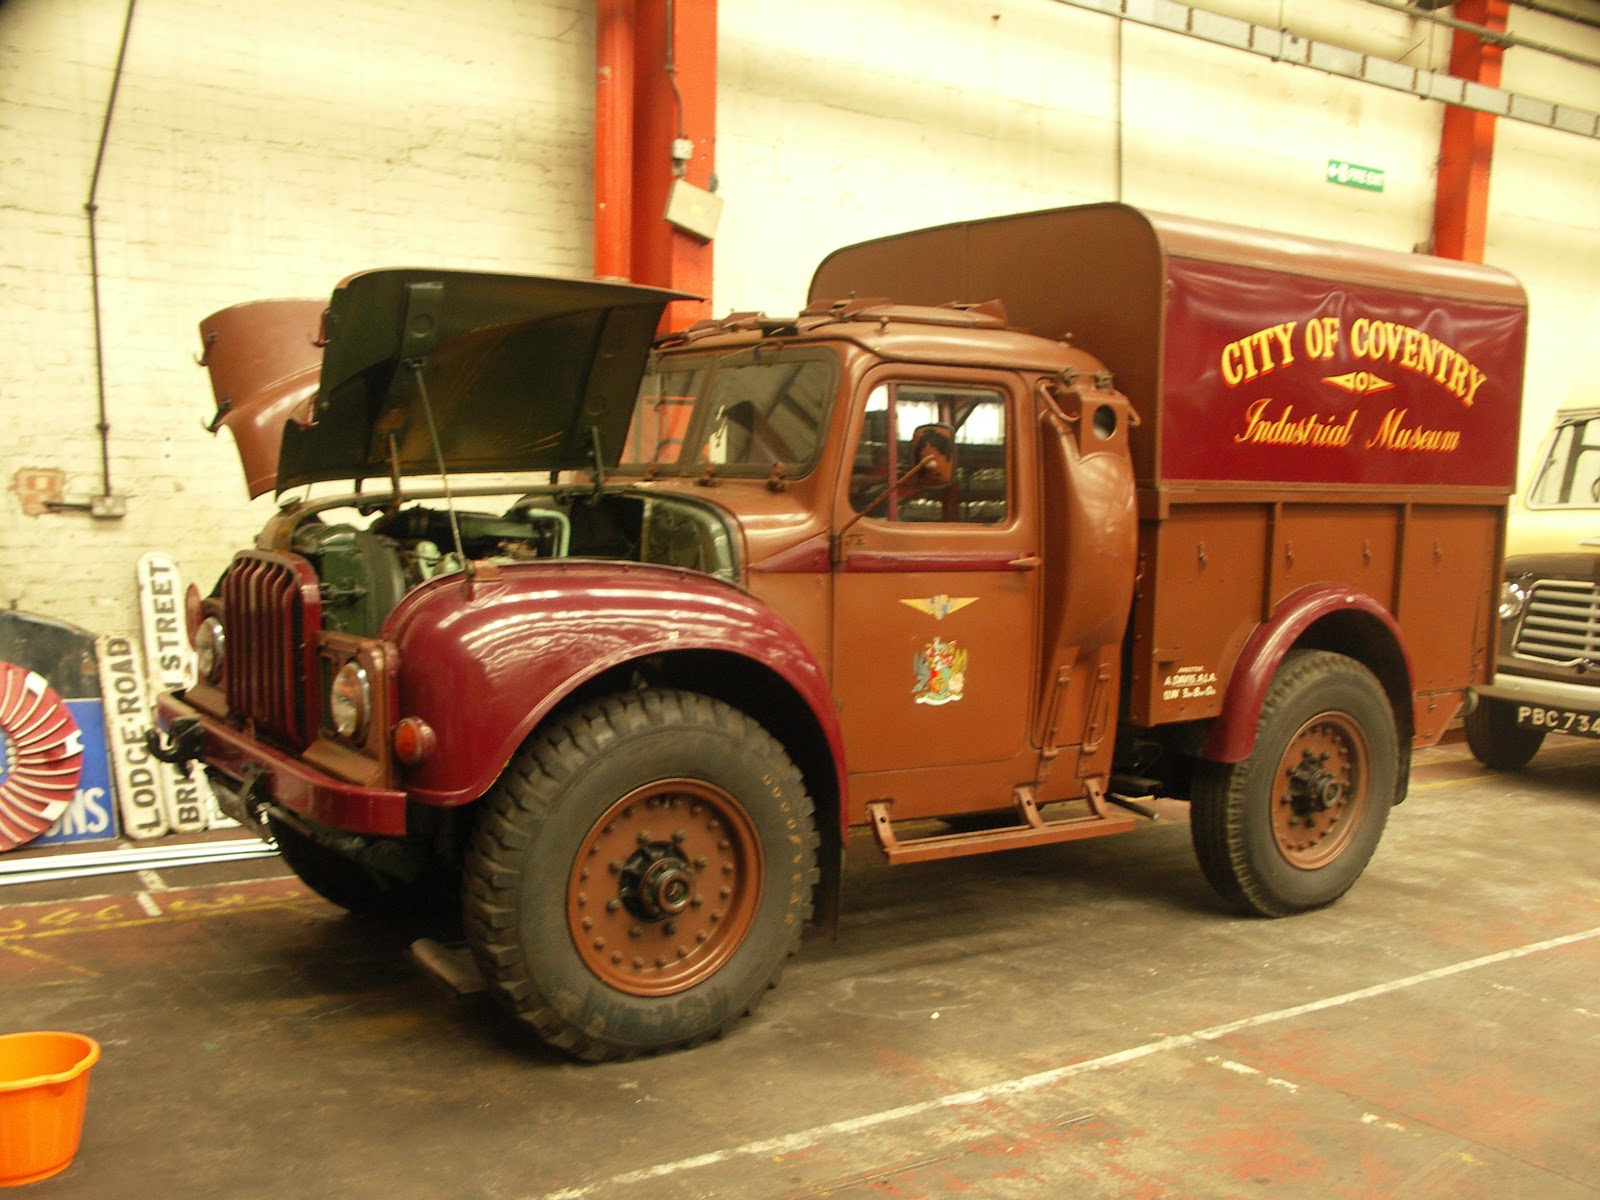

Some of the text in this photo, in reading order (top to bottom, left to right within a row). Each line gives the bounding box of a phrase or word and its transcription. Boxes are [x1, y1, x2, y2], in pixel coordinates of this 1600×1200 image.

[1221, 317, 1488, 408] CITY OF COVENTRY
[1234, 398, 1462, 451] Industrial Museum
[150, 560, 181, 670] STREET
[1518, 705, 1600, 735] PBC 734
